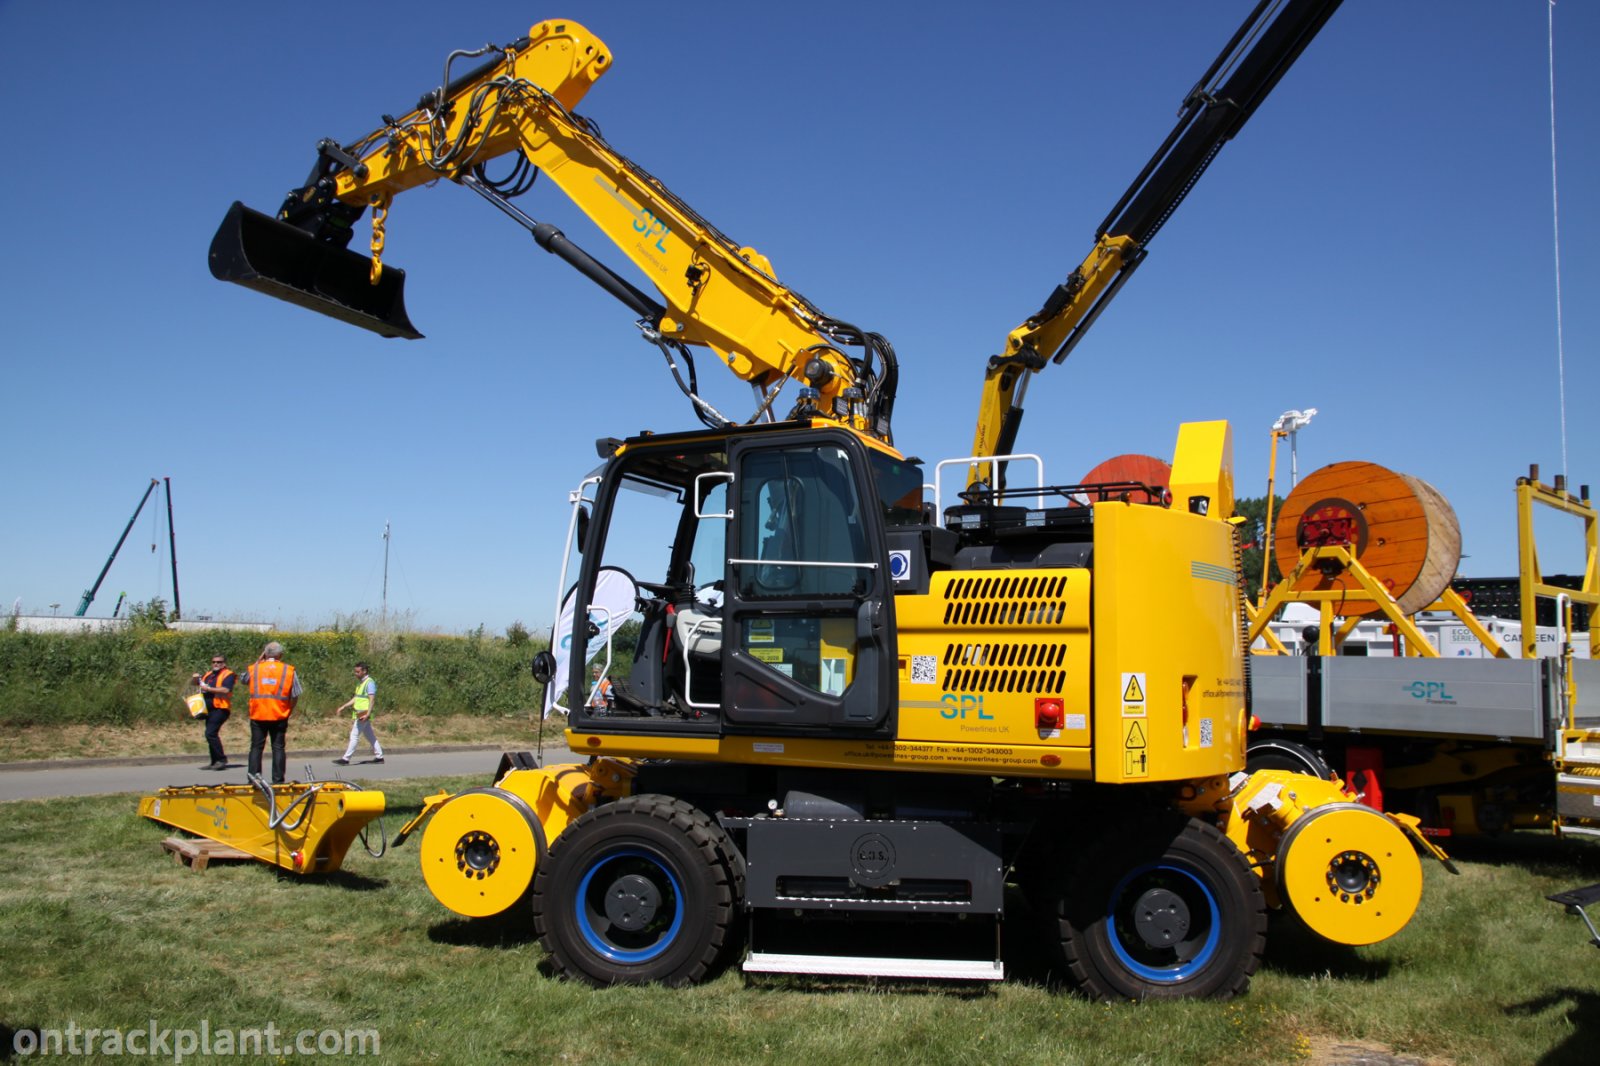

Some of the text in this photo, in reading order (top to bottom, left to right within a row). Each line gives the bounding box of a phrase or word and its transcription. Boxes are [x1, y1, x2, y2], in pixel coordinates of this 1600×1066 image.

[633, 208, 672, 253] SPL
[1411, 681, 1453, 699] SPL
[940, 694, 994, 719] SPL
[960, 725, 998, 733] Powerlines
[946, 755, 1038, 765] www.powerlines-group.com
